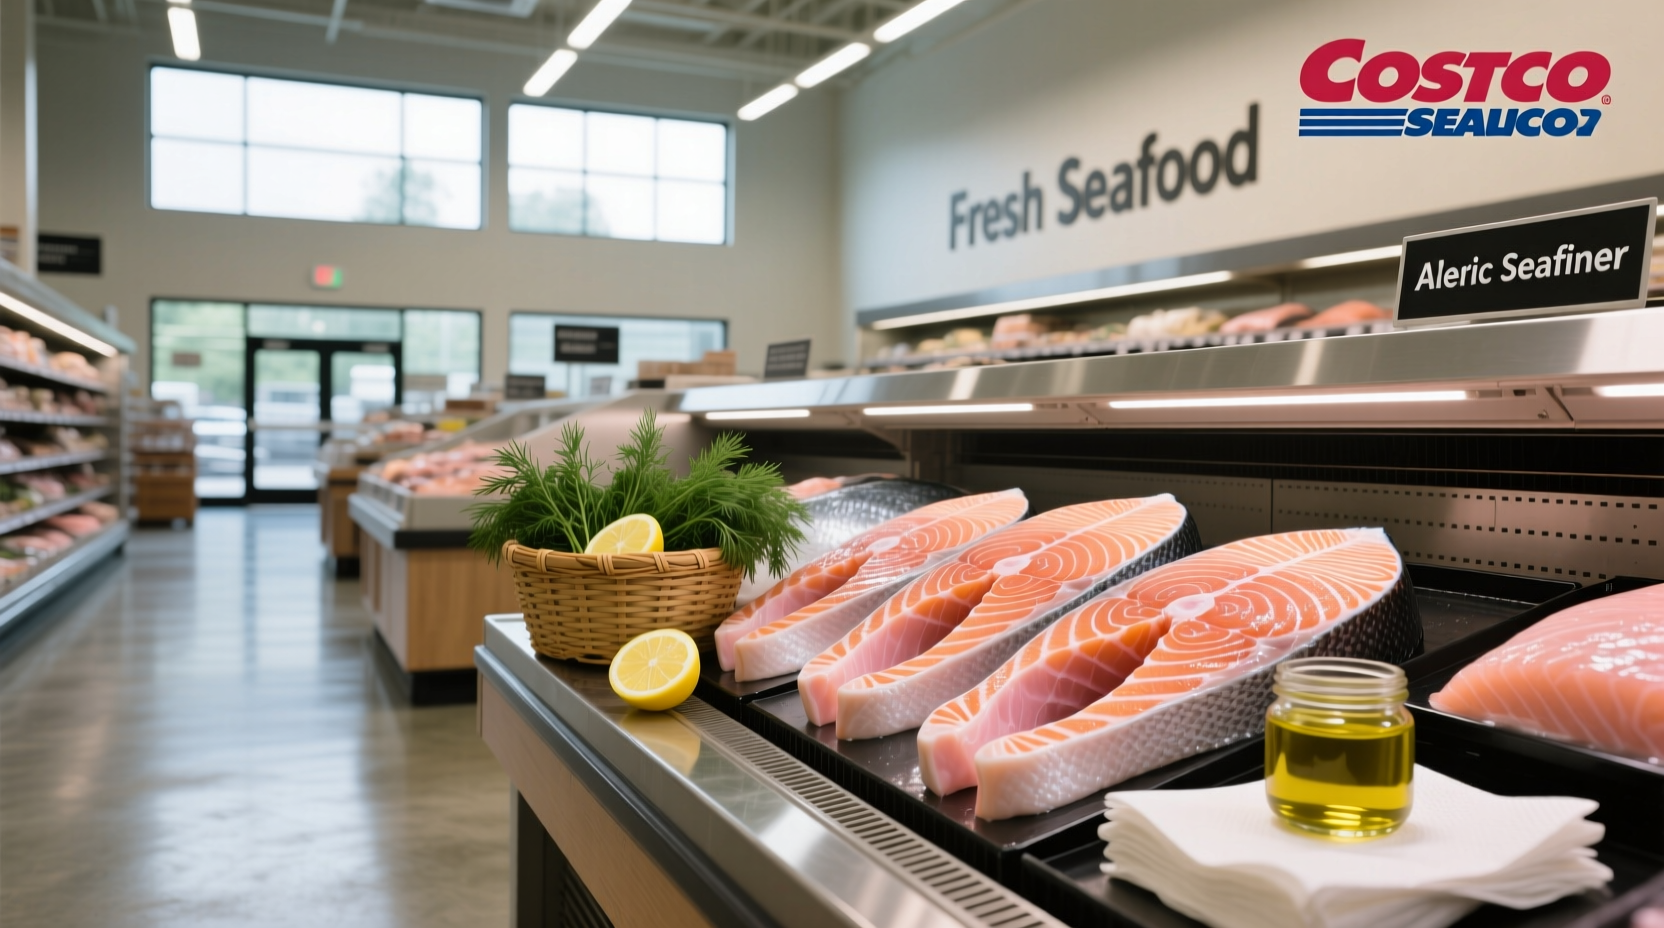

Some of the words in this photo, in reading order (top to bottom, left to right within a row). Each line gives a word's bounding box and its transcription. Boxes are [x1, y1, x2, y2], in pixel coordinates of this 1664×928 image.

[949, 170, 1043, 251] Fresh
[1057, 101, 1259, 226] Seafood
[1414, 256, 1493, 291] Aleric
[1500, 243, 1629, 282] Seafiner
